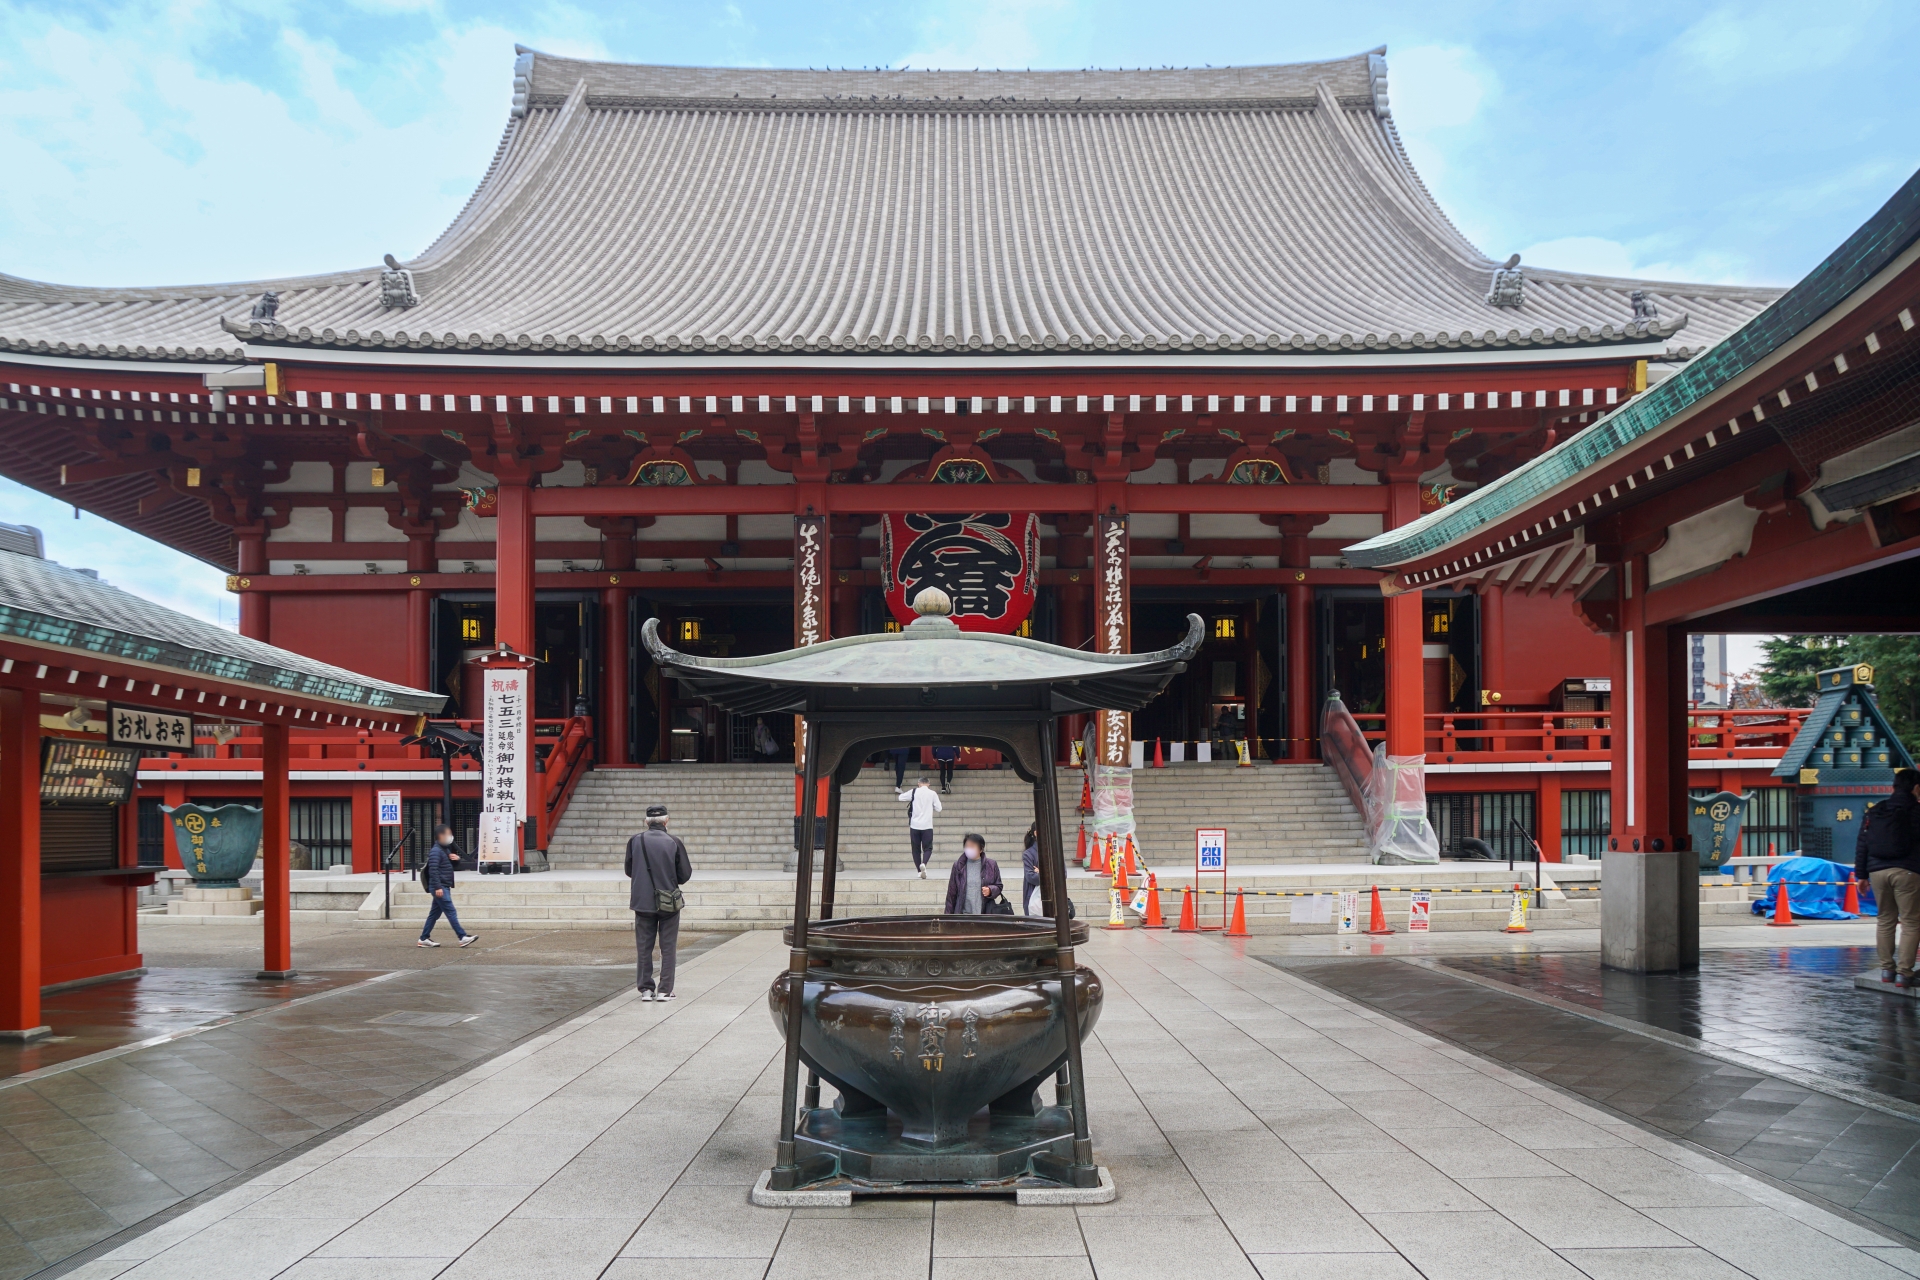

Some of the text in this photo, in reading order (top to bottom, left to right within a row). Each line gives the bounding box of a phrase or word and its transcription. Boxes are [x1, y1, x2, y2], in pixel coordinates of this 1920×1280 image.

[498, 694, 515, 729] 七五三
[117, 713, 186, 744] お札お守
